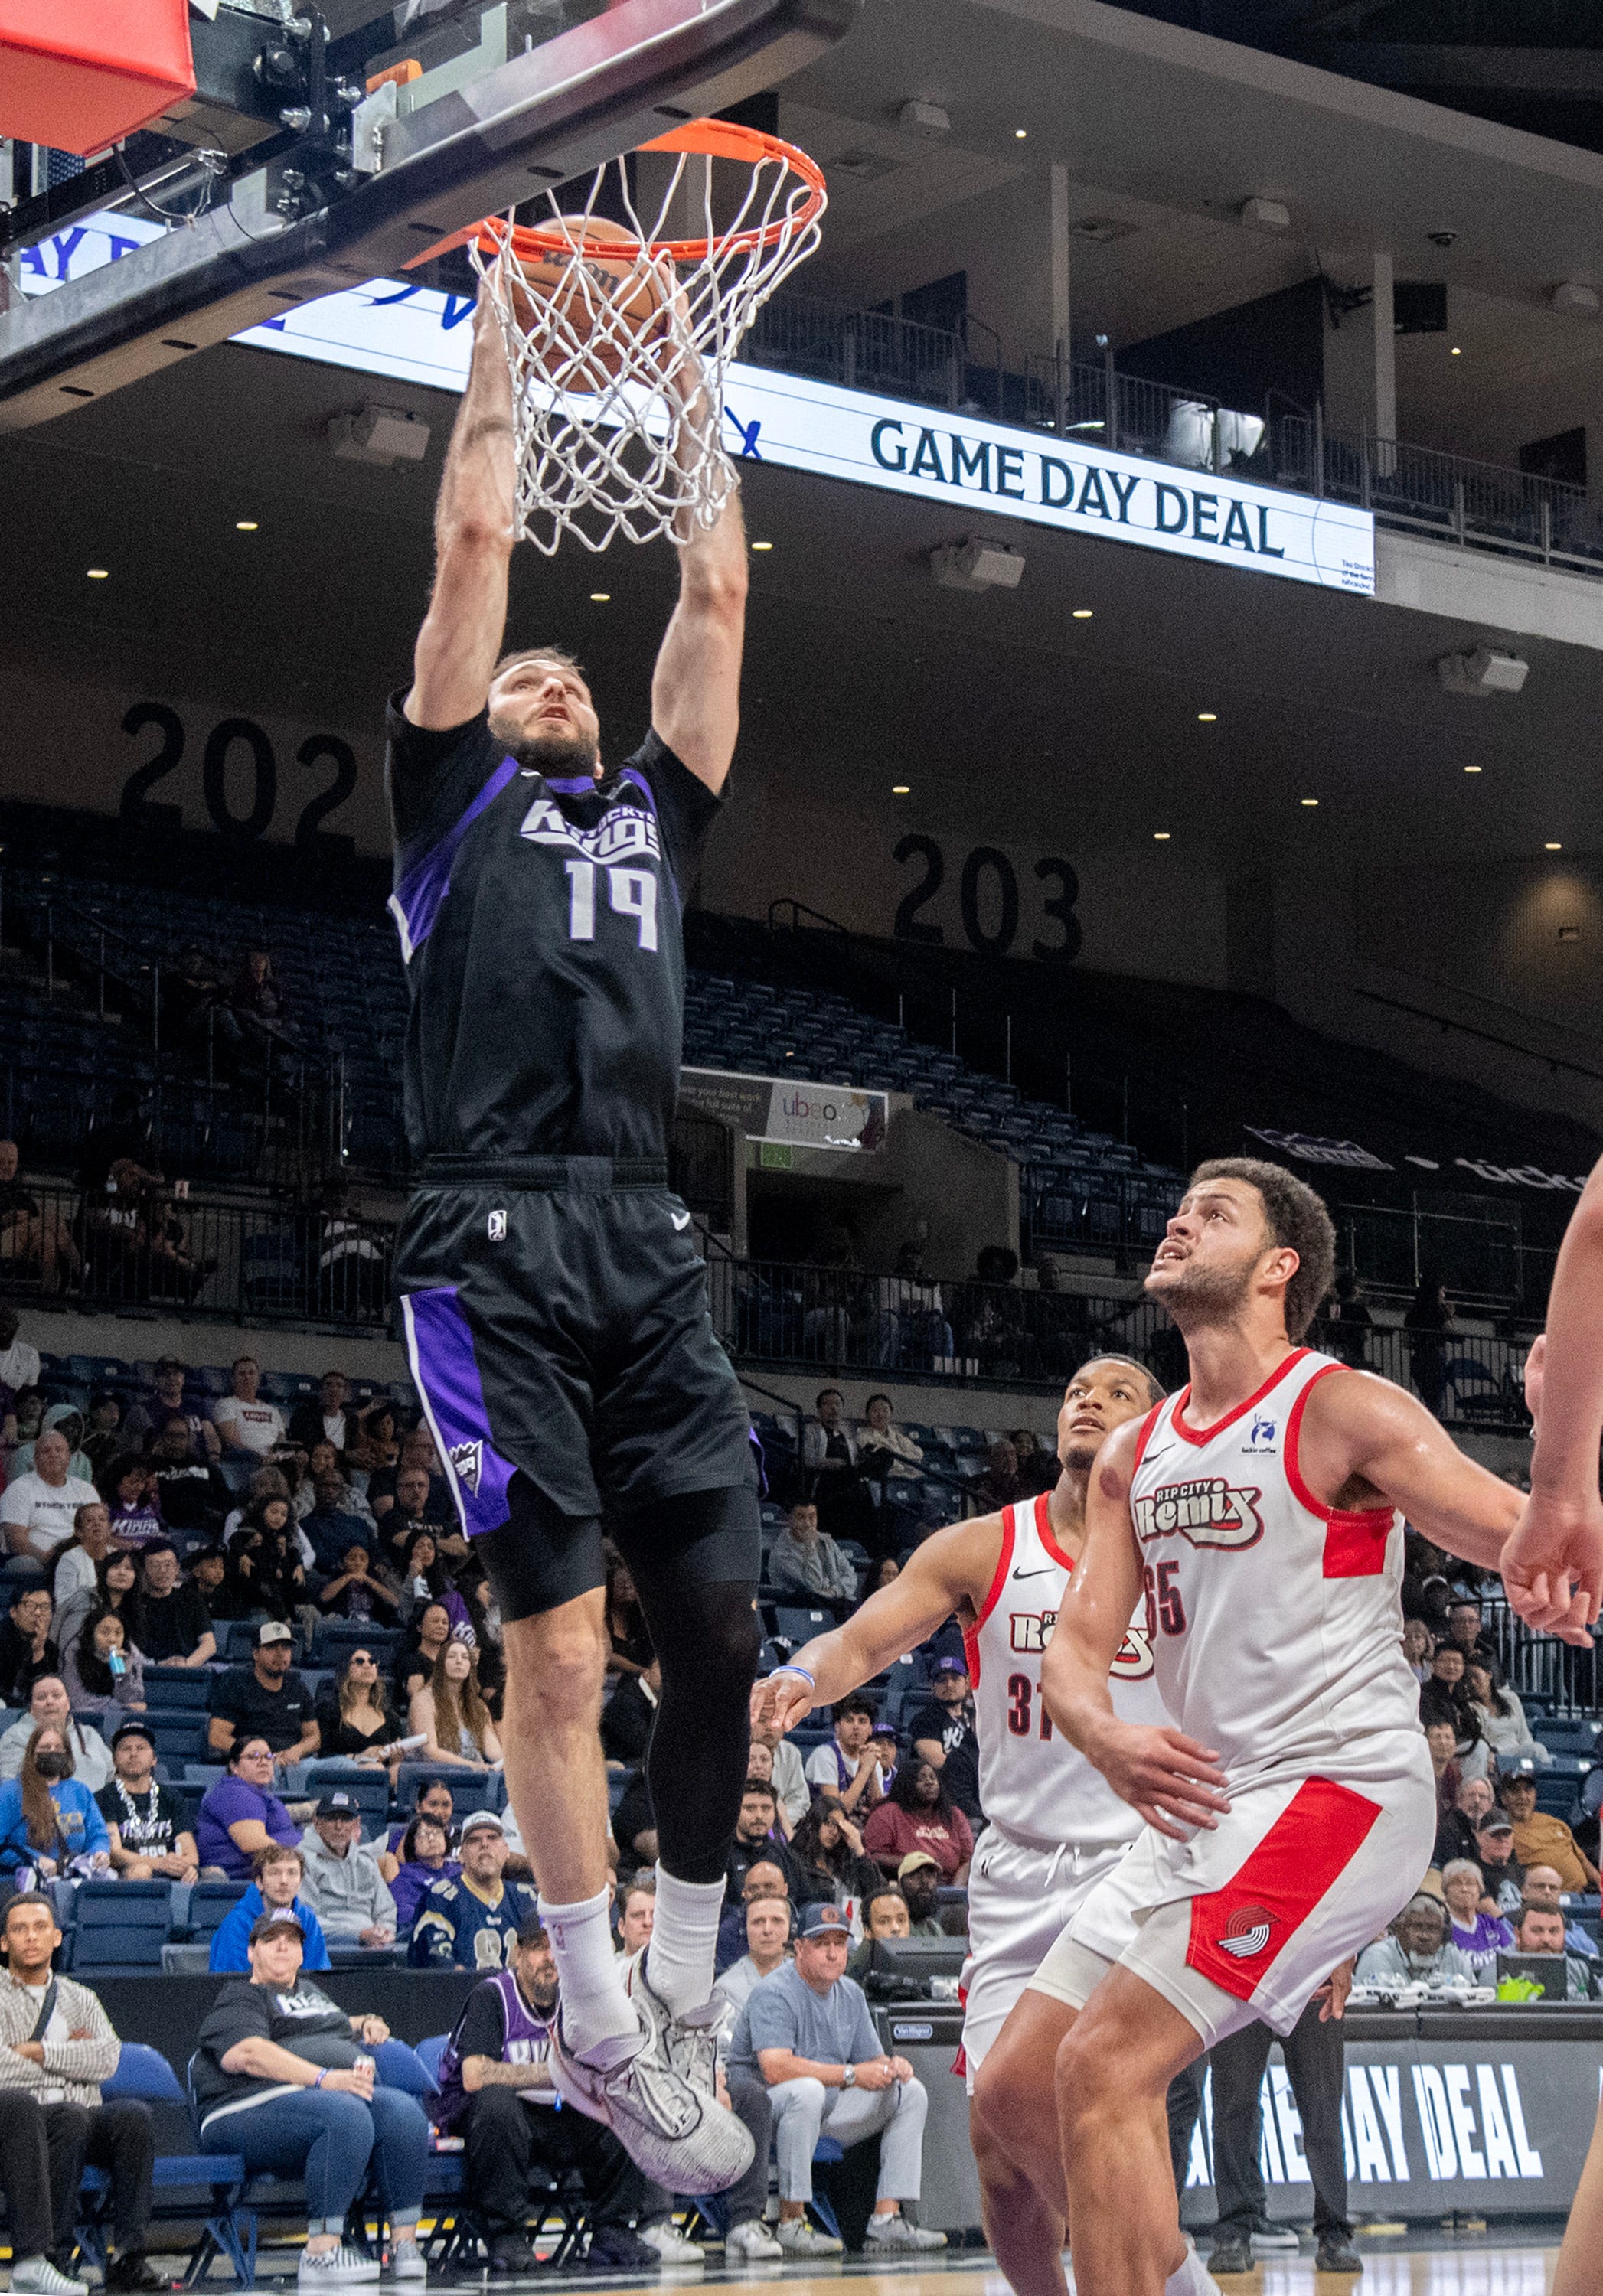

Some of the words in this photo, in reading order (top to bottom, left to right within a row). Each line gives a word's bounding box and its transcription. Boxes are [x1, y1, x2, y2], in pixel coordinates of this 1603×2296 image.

[871, 418, 1025, 499] GAME
[1039, 455, 1140, 523] DAY
[1154, 481, 1285, 558] DEAL
[121, 702, 357, 852] 202
[564, 859, 658, 952] 19
[893, 833, 1083, 963] 203
[783, 1091, 837, 1121] ubeo
[1135, 1479, 1265, 1551] Remix
[1157, 1487, 1179, 1502] RIP
[1180, 1481, 1211, 1496] CITY
[1411, 2063, 1545, 2181] DEAL
